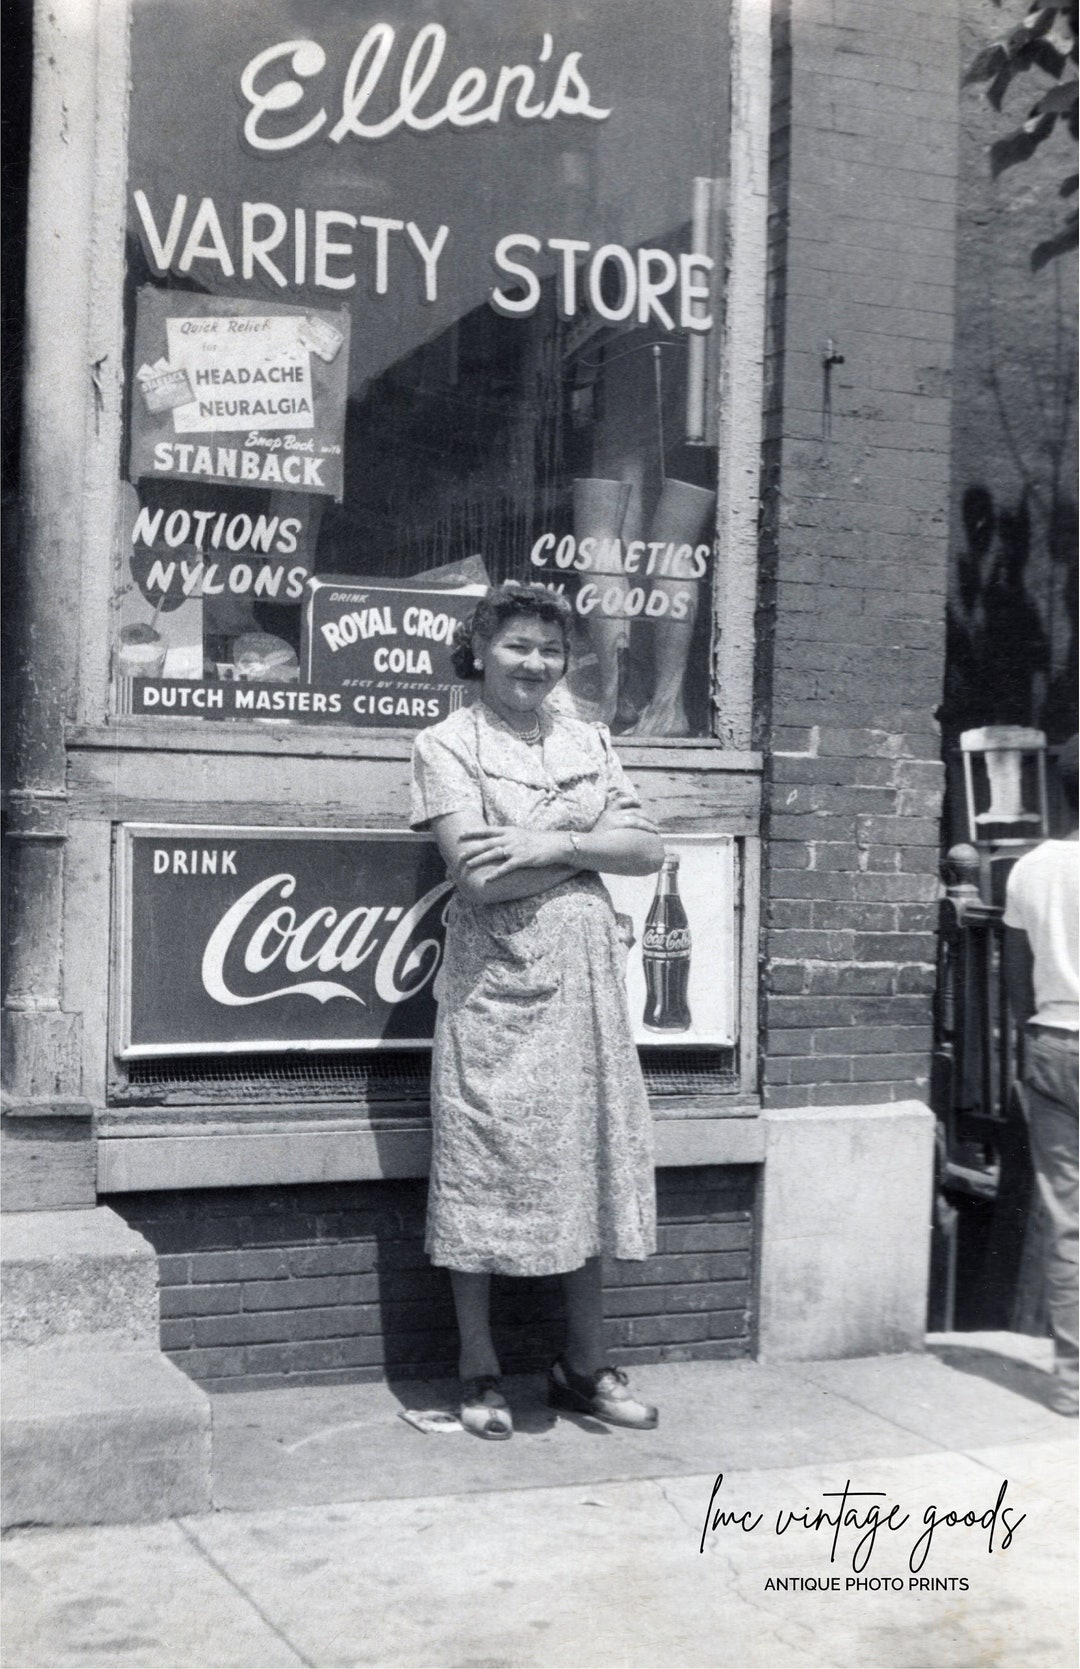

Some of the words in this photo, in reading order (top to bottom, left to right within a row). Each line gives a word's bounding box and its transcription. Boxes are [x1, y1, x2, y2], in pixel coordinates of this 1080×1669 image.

[240, 22, 612, 151] Ellen's
[133, 189, 449, 301] VARIETY
[492, 233, 714, 331] STORE
[180, 321, 218, 335] Quick
[227, 319, 272, 333] Relief
[195, 366, 304, 385] HEADACHE
[199, 397, 312, 417] NEURALGIA
[245, 430, 282, 452] Snap
[283, 434, 314, 453] Back
[153, 442, 325, 487] STANBACK
[132, 507, 302, 553] NOTIONS
[530, 532, 711, 579] COSMETICS
[147, 560, 308, 599] NYLONS
[329, 592, 368, 602] DRINK
[574, 583, 691, 620] GOODS
[321, 607, 397, 652] ROYAL
[374, 648, 433, 675] COLA
[143, 686, 223, 709] DUTCH
[235, 691, 342, 713] MASTERS
[353, 695, 440, 717] CIGARS
[153, 850, 238, 875] DRINK
